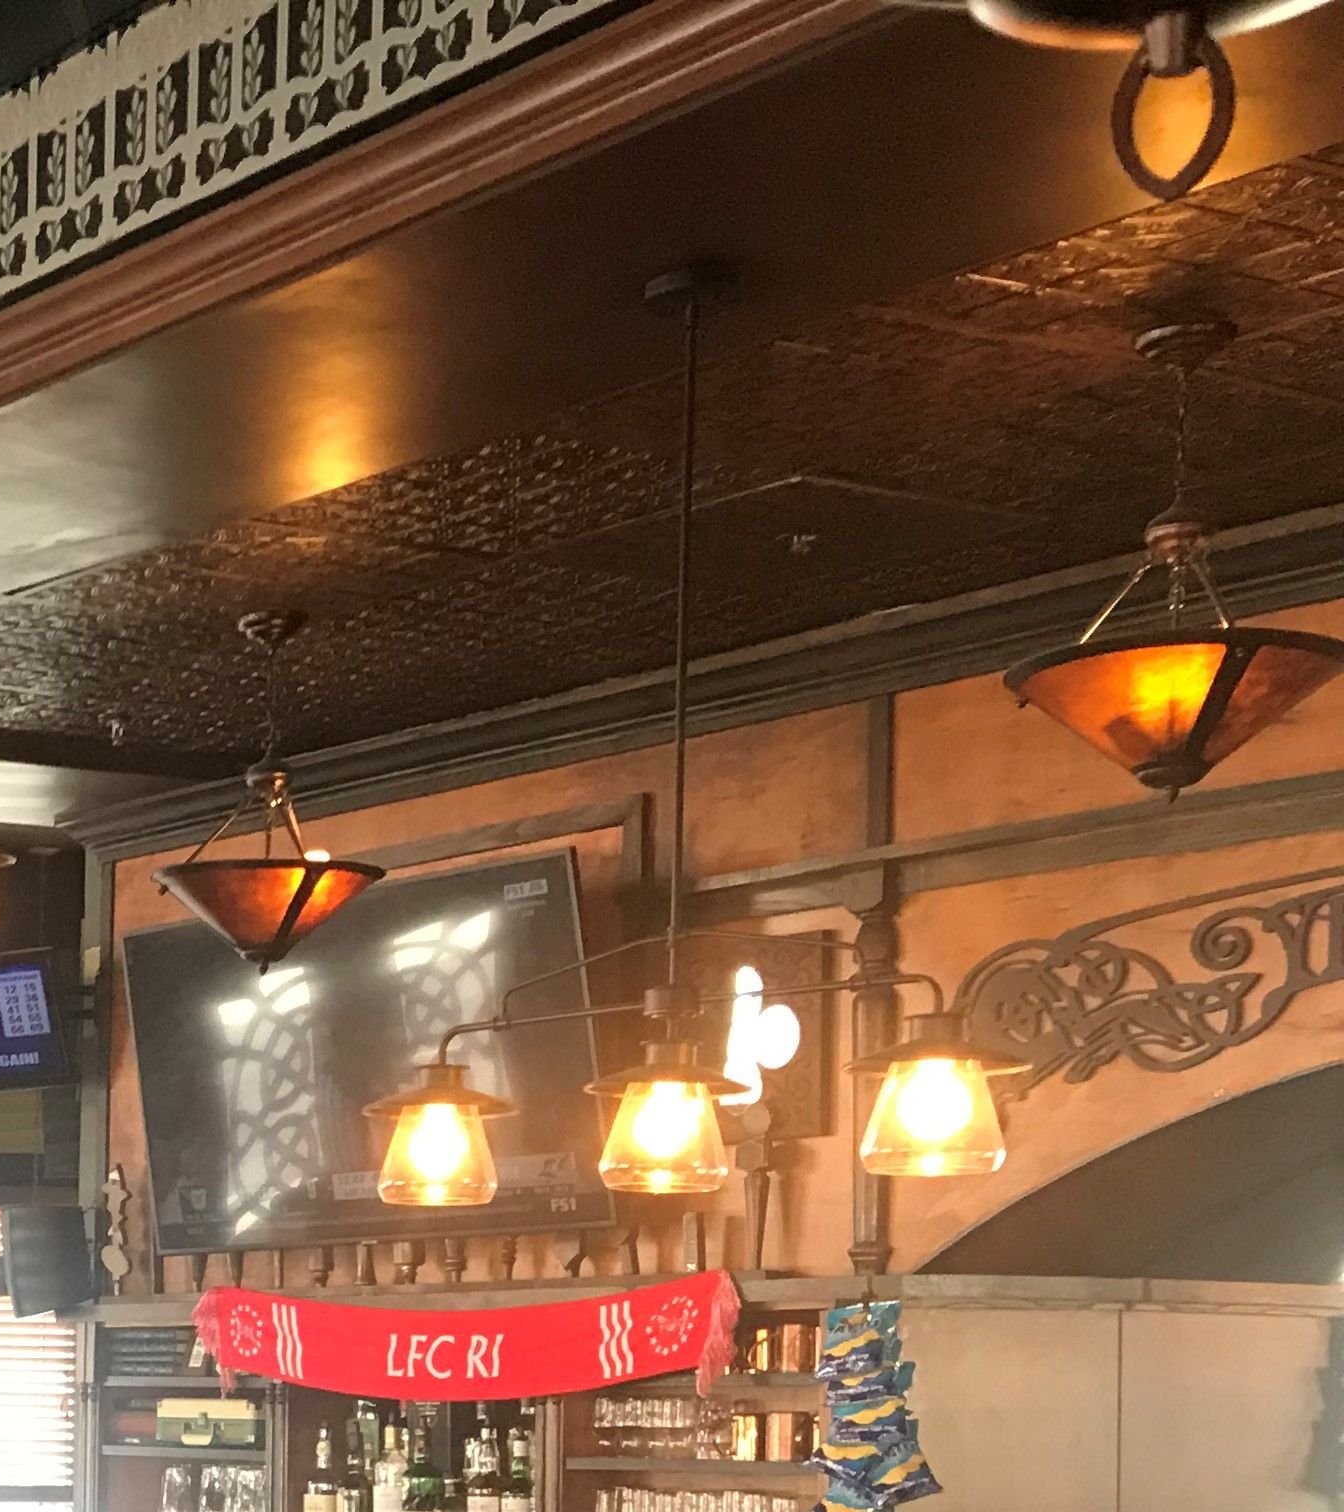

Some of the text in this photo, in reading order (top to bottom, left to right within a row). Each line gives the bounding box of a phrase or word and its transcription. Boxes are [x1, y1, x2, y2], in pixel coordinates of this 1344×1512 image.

[550, 1197, 576, 1212] FS1
[386, 1331, 505, 1381] LFC RI
